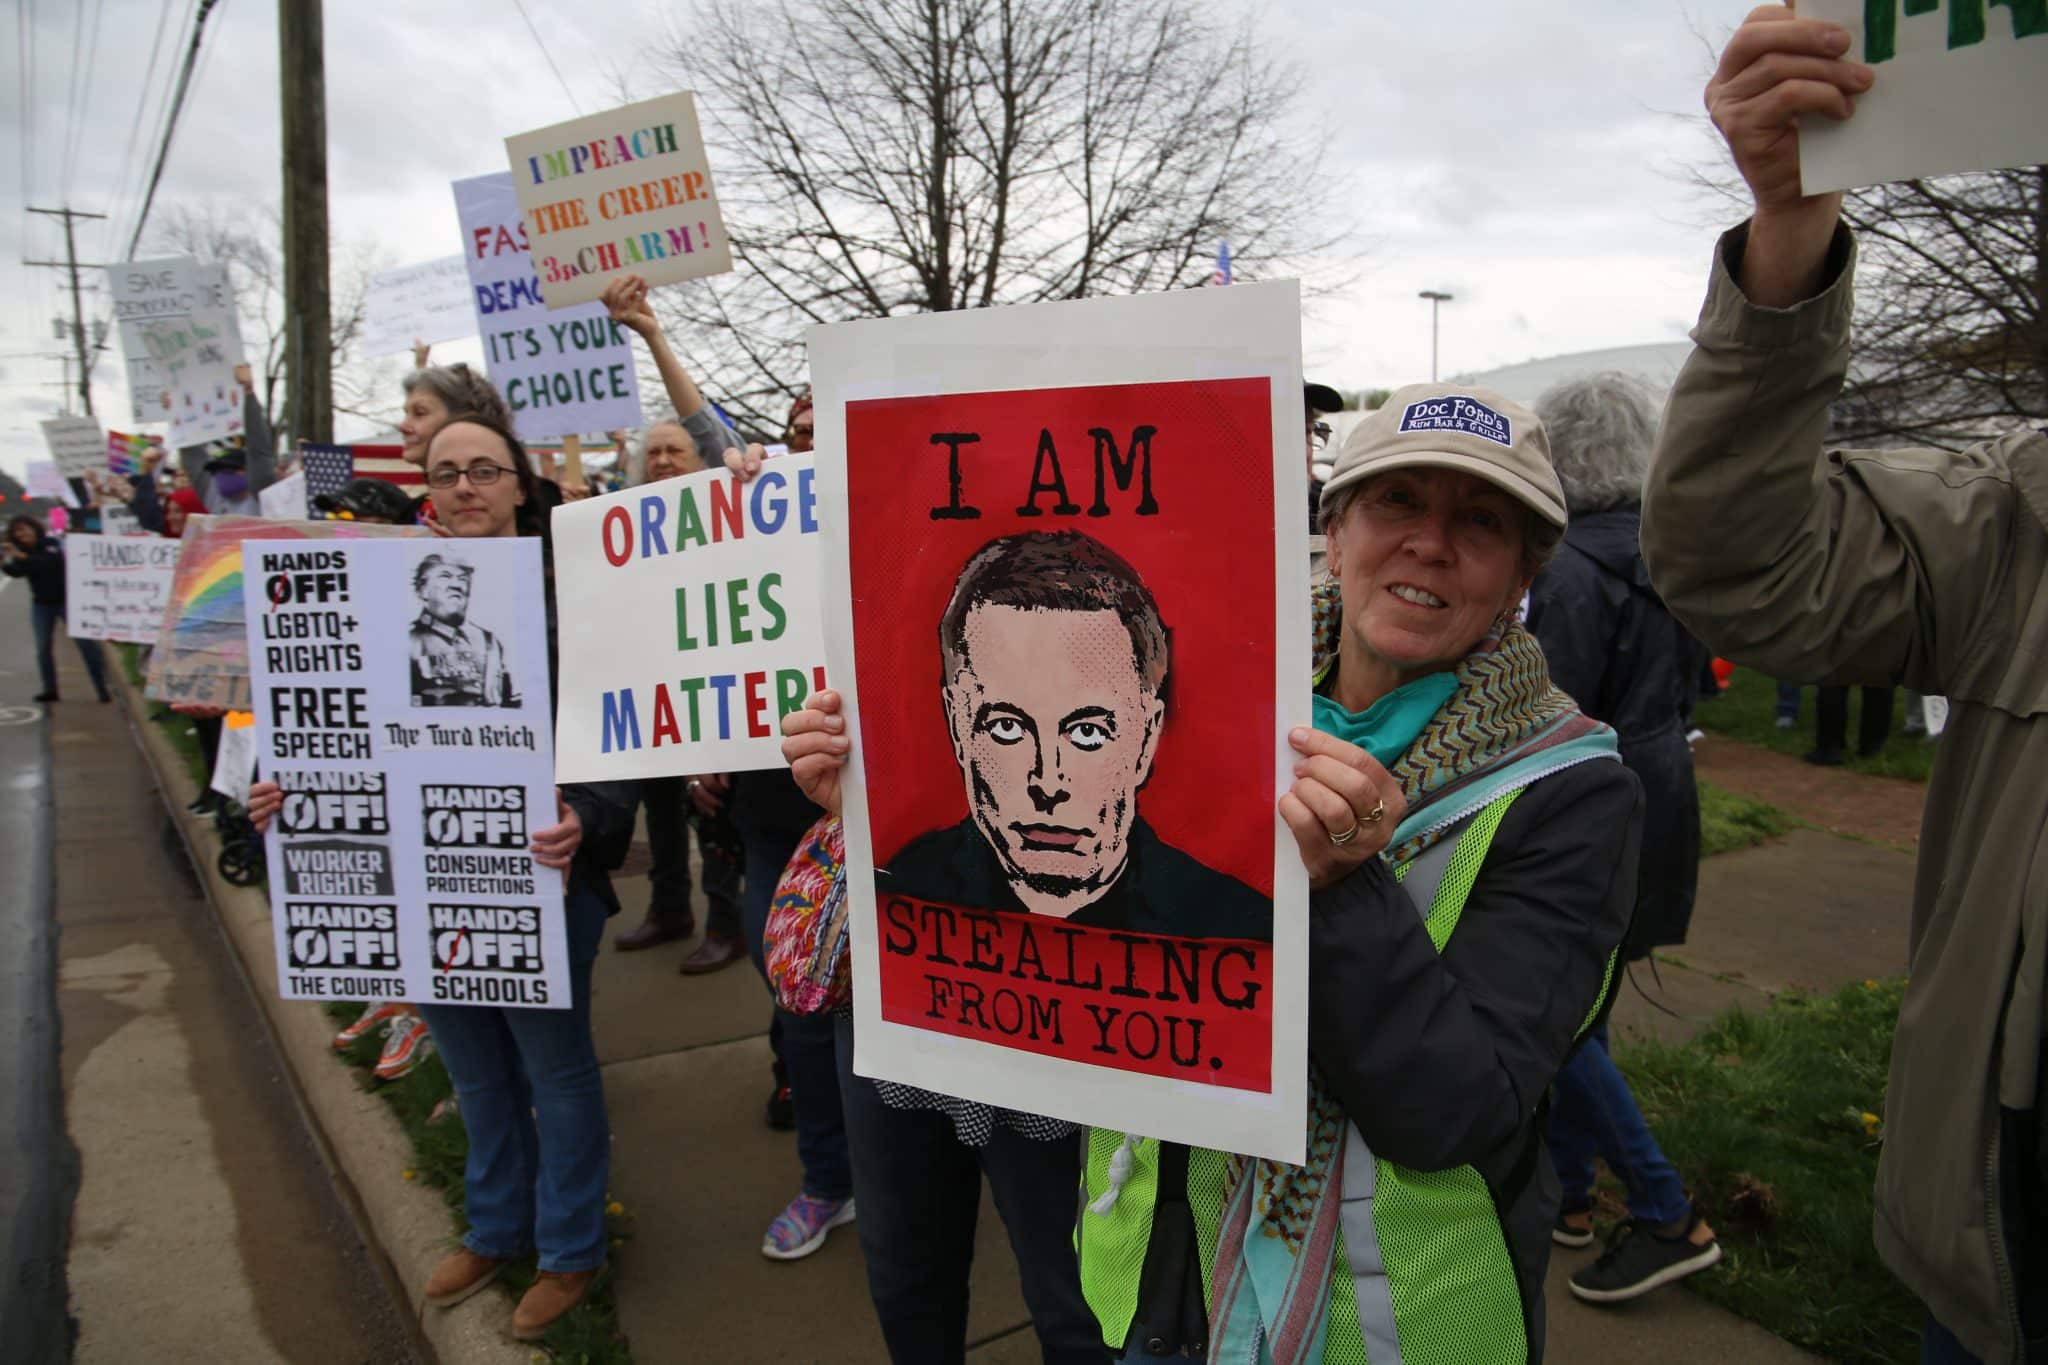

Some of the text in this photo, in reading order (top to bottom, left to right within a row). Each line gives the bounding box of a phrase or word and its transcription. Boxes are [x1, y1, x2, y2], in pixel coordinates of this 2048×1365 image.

[528, 123, 679, 185] IMPEACH
[529, 171, 708, 235] THE CREEP.
[474, 221, 531, 259] FAS
[490, 315, 625, 363] IT'S YOUR
[506, 364, 630, 411] CHOICE
[930, 425, 1159, 520] I AM
[602, 468, 818, 567] ORANGE
[262, 551, 347, 572] HANDS
[262, 612, 359, 640] LGBTQ+
[676, 572, 787, 651] LIES
[266, 643, 363, 673] RIGHTS
[270, 687, 370, 729] FREE
[272, 732, 372, 760] SPEECH
[384, 723, 536, 751] The Turd Reich
[278, 772, 383, 792] HANDS
[423, 787, 523, 809] HANDS
[281, 793, 387, 831] OFF!
[427, 810, 526, 846] OFF!
[286, 850, 384, 873] WORKER
[425, 854, 533, 876] CONSUMER
[298, 873, 377, 895] RIGHTS
[427, 877, 535, 895] PROTECTIONS
[289, 906, 394, 929] HANDS
[432, 907, 538, 932] HANDS
[292, 930, 398, 967] OFF!
[435, 931, 541, 969] OFF!
[886, 901, 1262, 1010] STEALING
[288, 975, 406, 997] THE COURTS
[433, 976, 549, 1004] SCHOOLS
[924, 973, 1223, 1070] FROM YOU.
